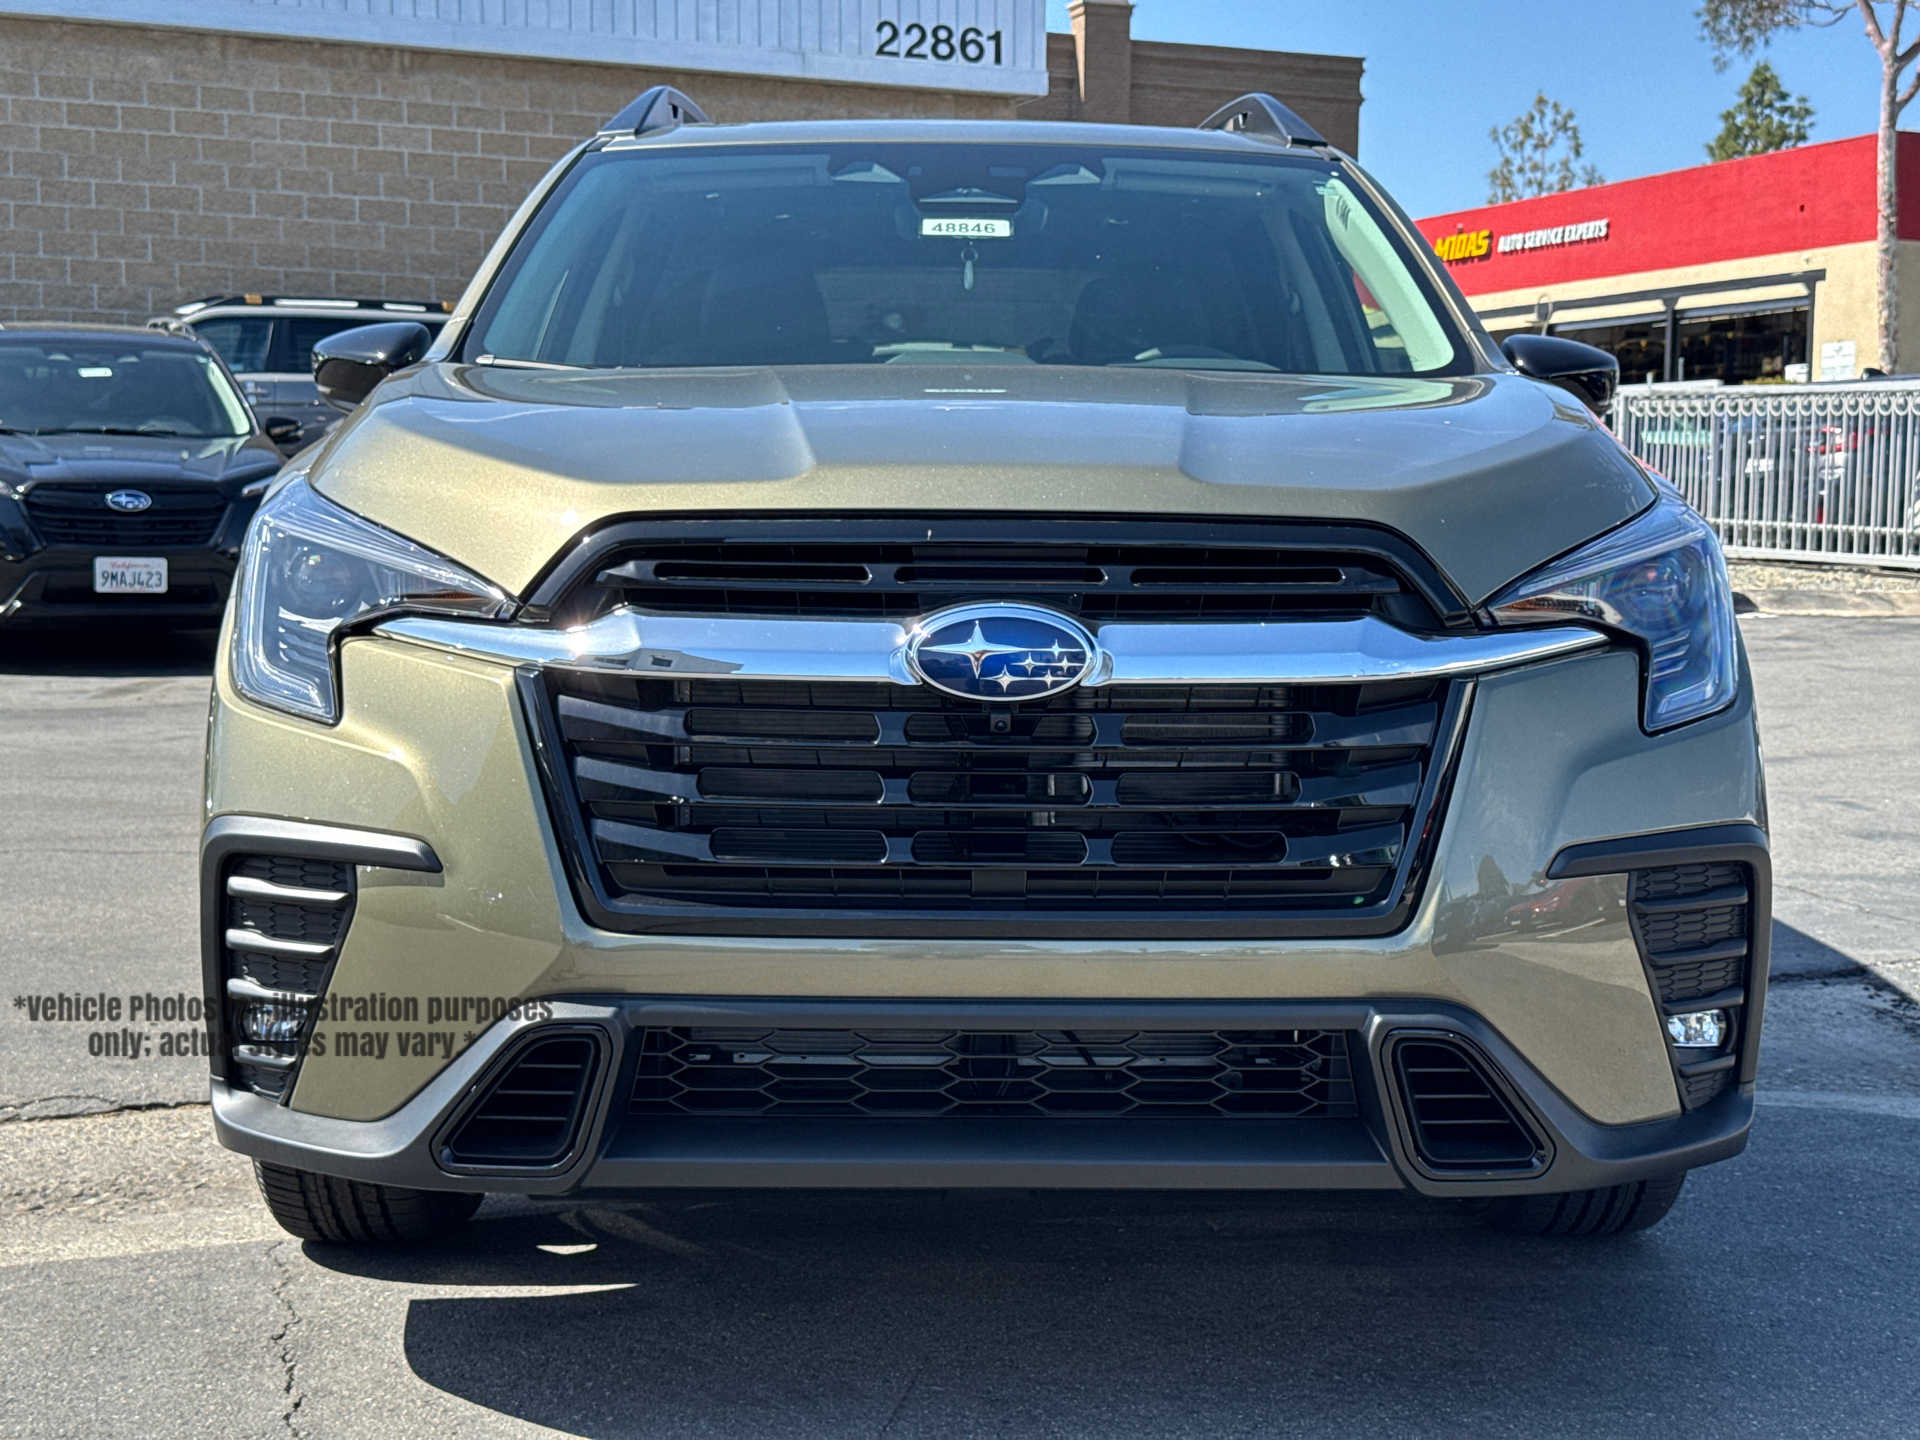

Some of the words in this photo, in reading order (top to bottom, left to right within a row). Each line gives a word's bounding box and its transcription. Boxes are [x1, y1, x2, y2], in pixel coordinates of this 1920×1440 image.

[875, 20, 1003, 66] 22861
[931, 222, 996, 234] 48846
[1497, 232, 1524, 253] AUTO
[1524, 226, 1565, 249] SERVICE
[1564, 218, 1609, 243] EXPERTS
[1434, 229, 1490, 261] MIDAS
[101, 570, 163, 588] 9MAJ423
